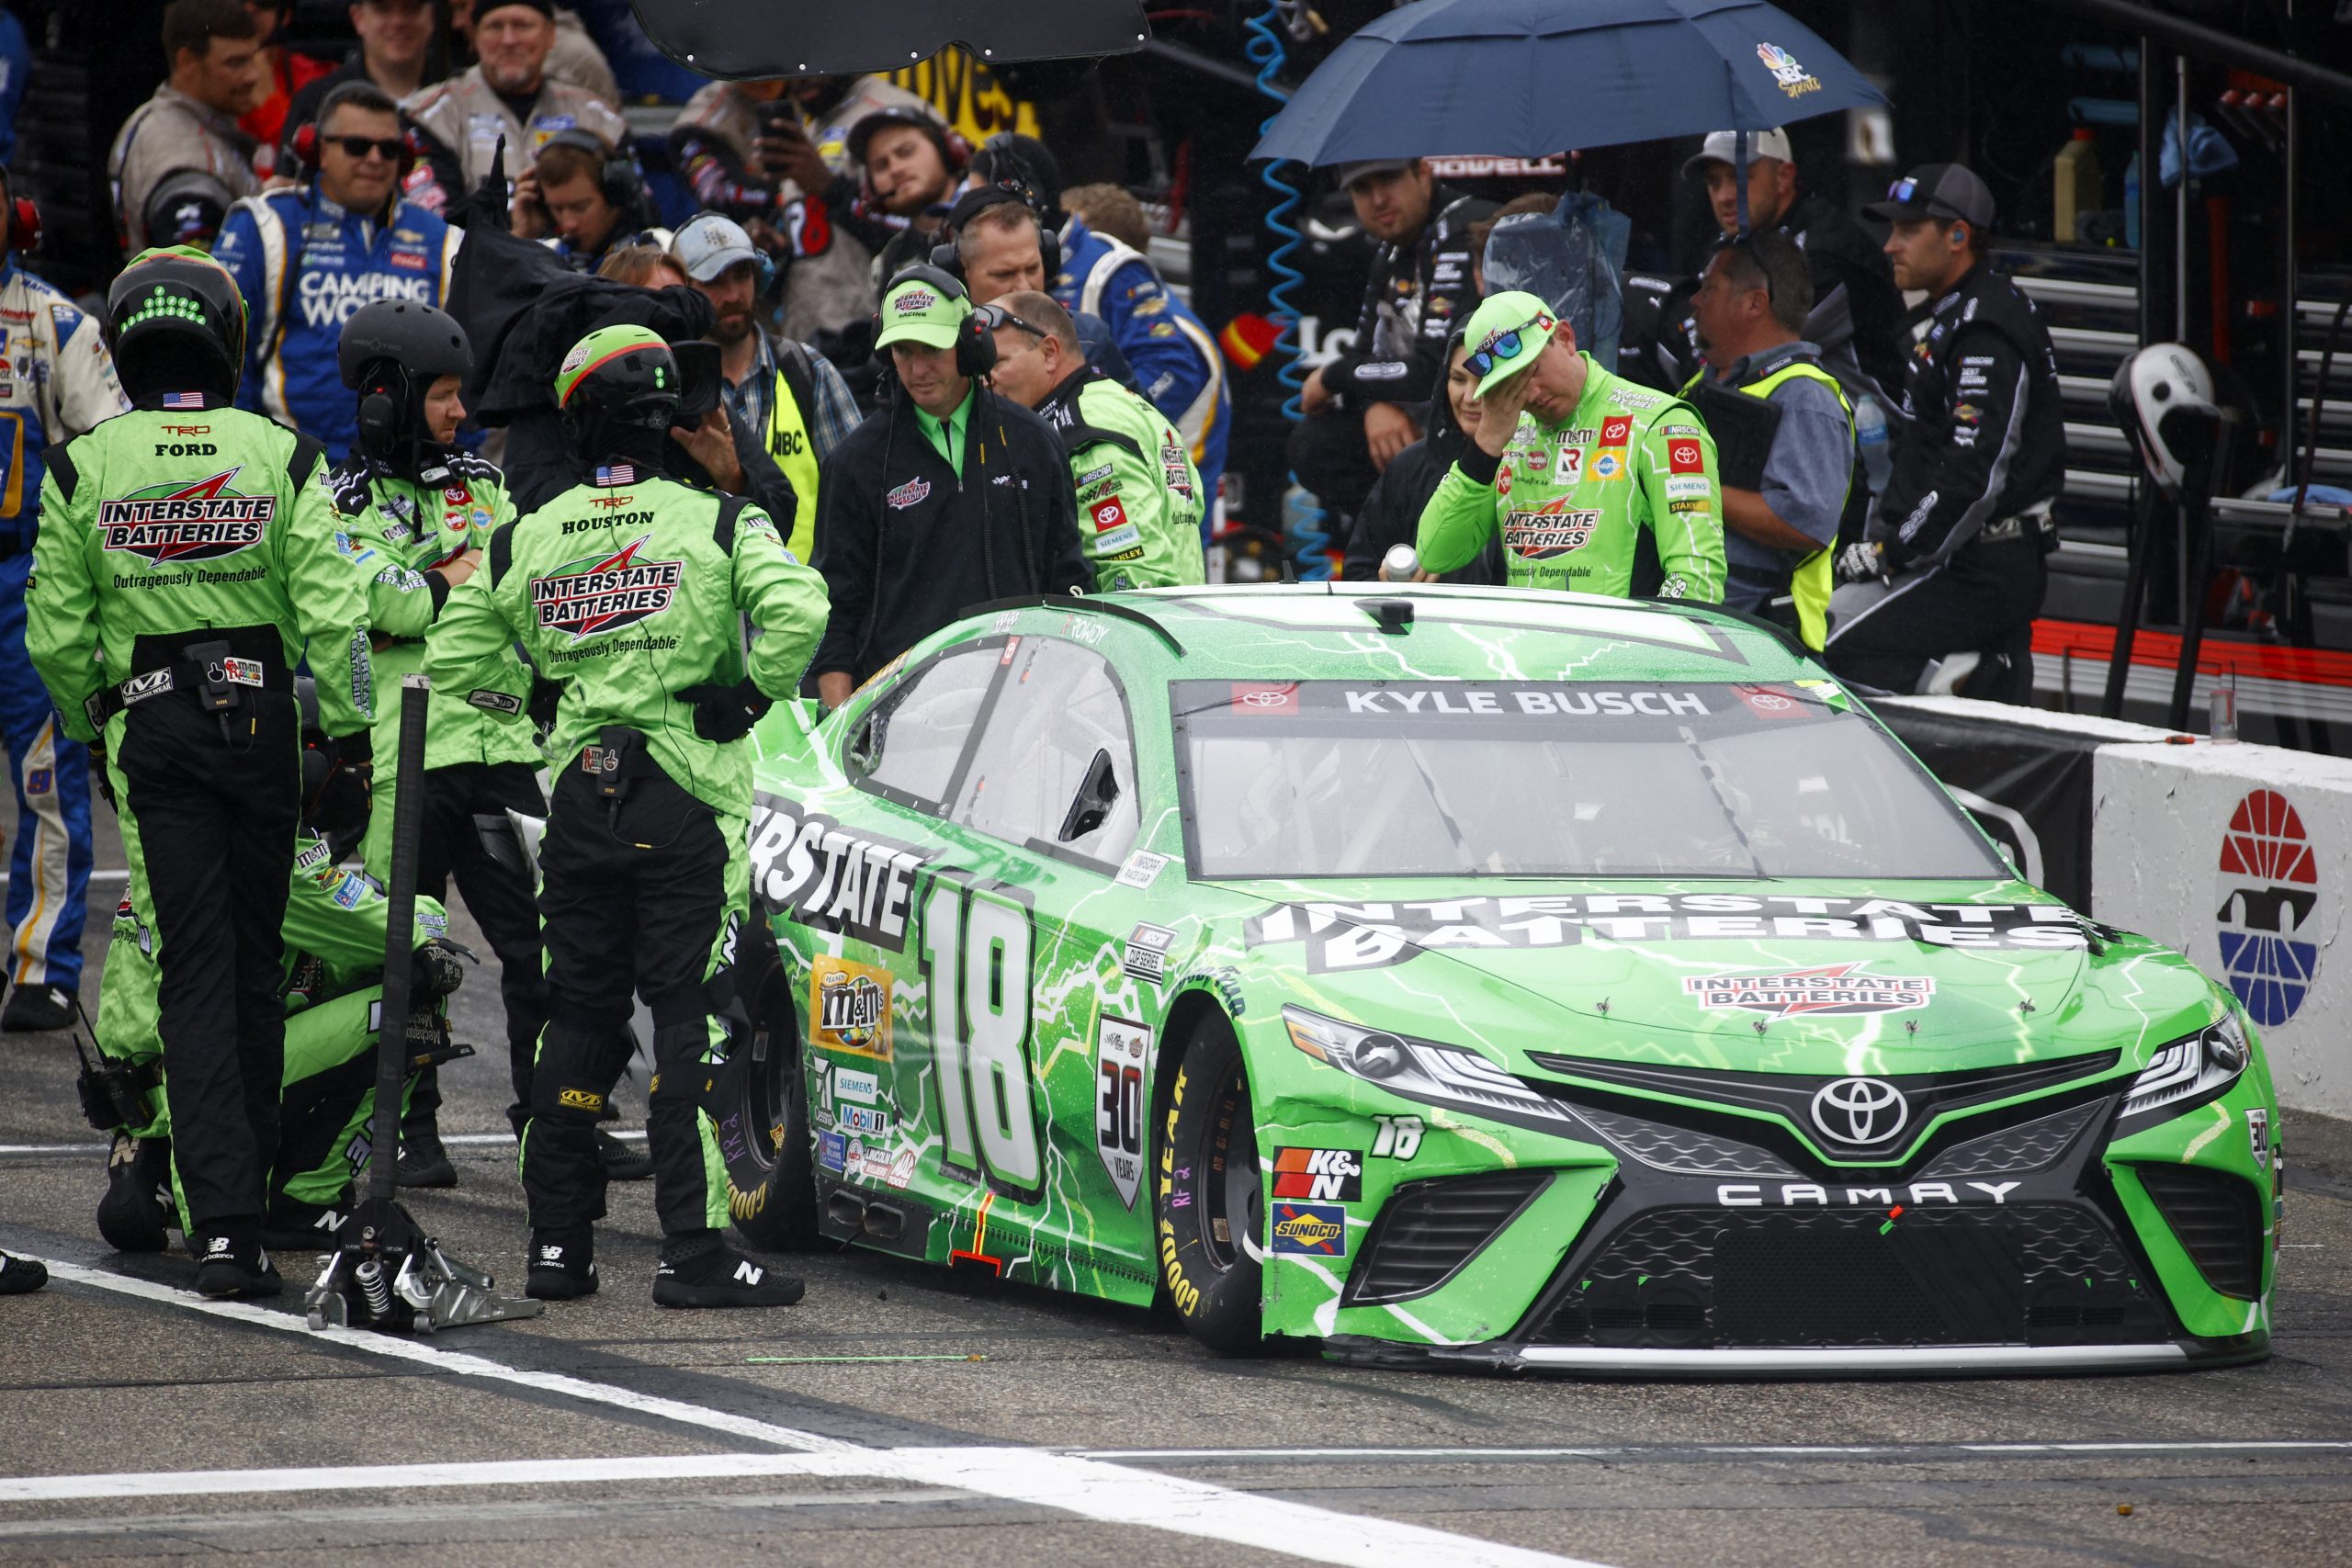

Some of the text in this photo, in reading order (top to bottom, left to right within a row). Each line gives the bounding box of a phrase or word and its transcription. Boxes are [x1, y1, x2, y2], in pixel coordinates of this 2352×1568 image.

[1772, 64, 1811, 84] NBC
[1778, 77, 1822, 98] Sports
[300, 271, 430, 304] CAMPING
[895, 294, 935, 304] INTERSTATE
[895, 300, 933, 310] BATTERIES
[1767, 356, 1792, 373] NASCAR
[1965, 356, 1995, 366] NASCAR
[1960, 376, 1987, 385] WIZARD
[161, 425, 209, 436] TRD
[1671, 425, 1700, 435] NASCAR
[155, 444, 217, 457] FORD
[1083, 464, 1112, 482] NASCAR
[1669, 483, 1707, 491] SIEMENS
[104, 499, 271, 522] INTERSTATE
[589, 496, 634, 510] TRD
[561, 512, 655, 535] HOUSTON
[110, 522, 260, 546] BATTERIES
[1100, 531, 1134, 547] SIEMENS
[1505, 530, 1587, 546] BATTERIES
[113, 568, 266, 590] Outrageously Dependable
[1540, 566, 1591, 578] Dependable
[535, 566, 678, 600] INTERSTATE
[542, 588, 668, 623] BATTERIES
[548, 642, 610, 663] Outrageously
[1344, 691, 1711, 716] KYLE BUSCH
[28, 768, 52, 795] 9
[1125, 869, 1151, 883] RACE CAR
[1262, 895, 2086, 941] INTERSTATE
[1325, 916, 2087, 967] BATTERIES
[1128, 949, 1159, 969] CUP SERIES
[825, 975, 844, 983] PEANUT
[1691, 977, 1928, 994] INTERSTATE
[1708, 990, 1923, 1007] BATTERIES
[922, 875, 1039, 1188] 18
[840, 1078, 873, 1094] SIEMENS
[814, 1105, 832, 1126] Cessna
[1101, 1058, 1142, 1156] 30
[843, 1106, 884, 1131] Mobil 1
[1370, 1114, 1426, 1161] 18
[2251, 1122, 2267, 1152] 30
[866, 1147, 891, 1164] LINCOLN
[1114, 1156, 1135, 1181] YEARS
[888, 1175, 908, 1189] TOOLS
[1308, 1175, 1344, 1200] N
[1717, 1181, 2022, 1206] CAMRY
[1278, 1223, 1339, 1238] SUNOCO
[540, 1260, 565, 1269] balance
